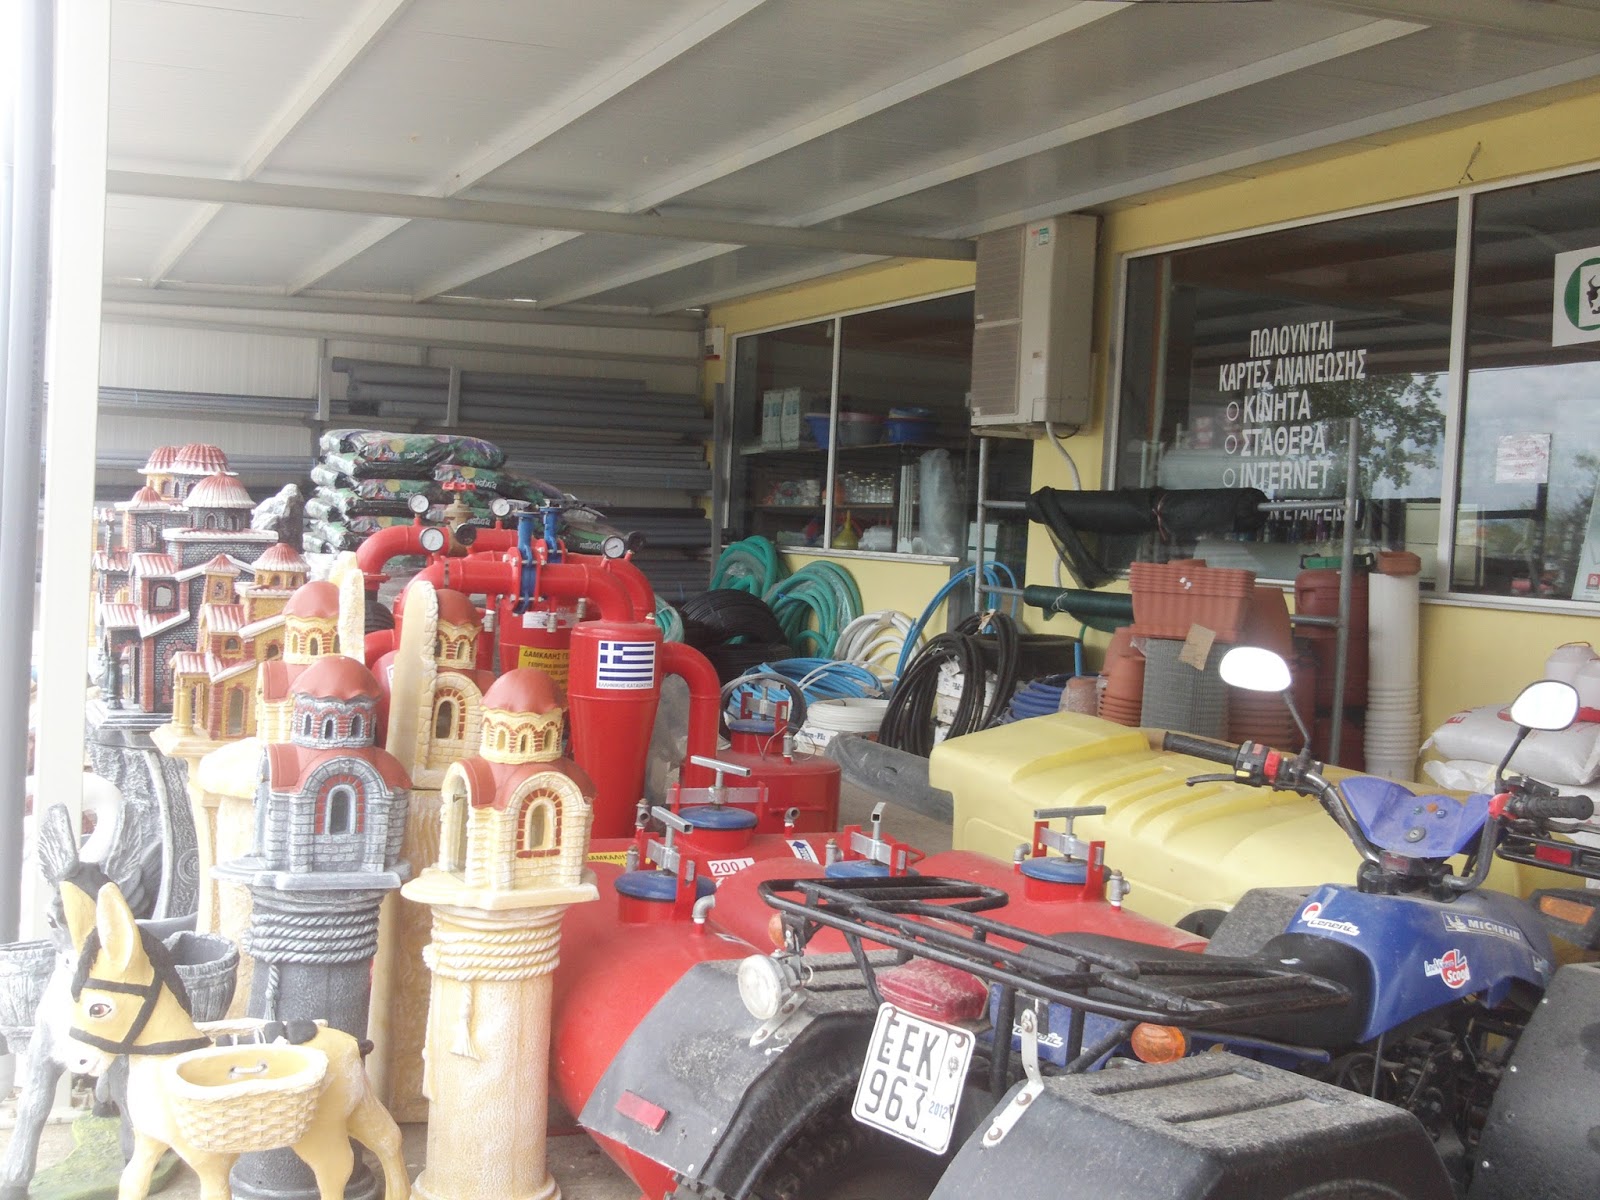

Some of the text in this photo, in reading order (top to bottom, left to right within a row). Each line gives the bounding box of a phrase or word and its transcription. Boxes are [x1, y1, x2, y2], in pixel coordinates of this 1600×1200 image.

[1249, 319, 1334, 358] ΠΩΛΟΥΝΤΑΙ
[1219, 349, 1367, 392] ΚΑΡΤΕΣ ΑΝΑΝΕΩΣΗΣ
[1243, 389, 1311, 424] ΚΙΝΗΤΑ
[1240, 425, 1326, 457] ΣΤΑΘΕΡΑ
[1239, 459, 1332, 490] INTERNET
[711, 861, 740, 874] 200
[1467, 919, 1521, 941] MICHELIN
[876, 1018, 942, 1081] EEK
[864, 1068, 929, 1130] 963
[928, 1100, 950, 1120] 2012
